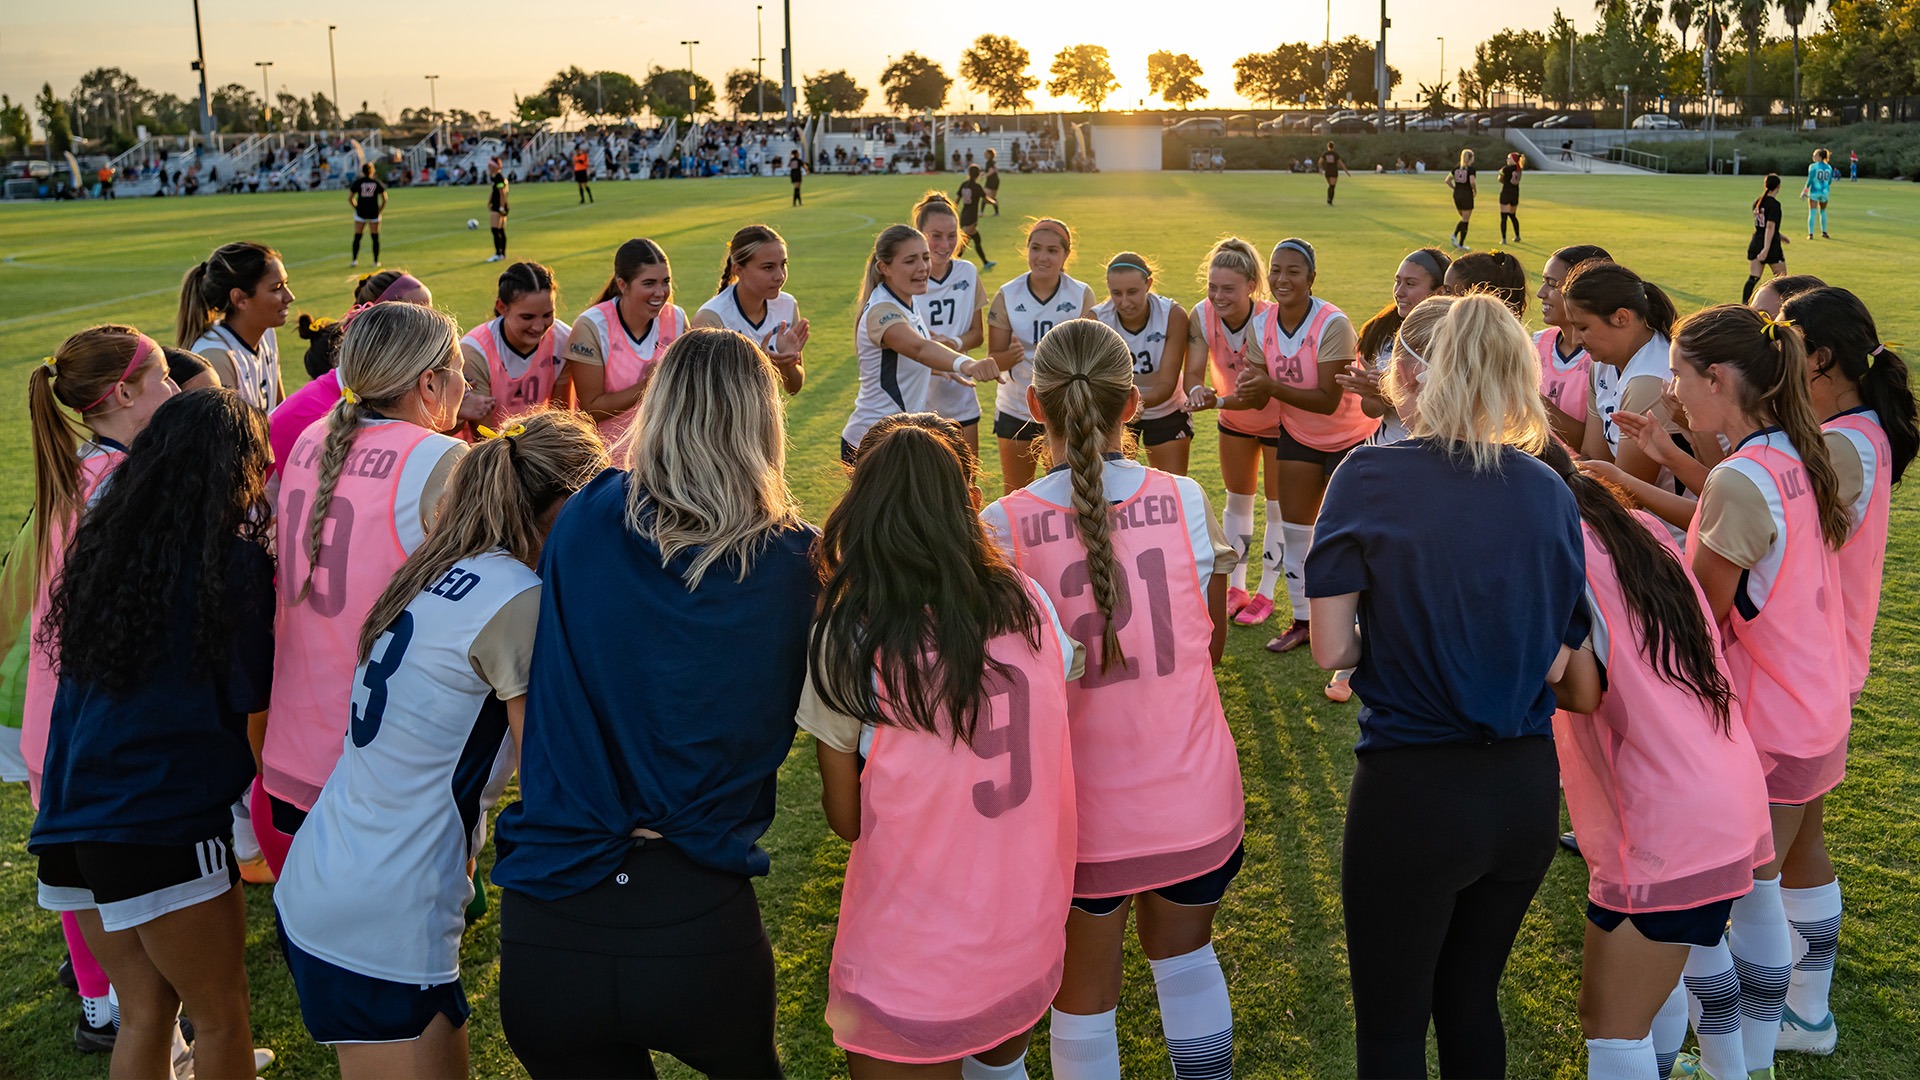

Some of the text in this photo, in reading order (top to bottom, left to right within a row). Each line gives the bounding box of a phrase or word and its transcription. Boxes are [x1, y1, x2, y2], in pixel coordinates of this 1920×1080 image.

[360, 182, 377, 198] 17
[929, 298, 955, 326] 27
[1033, 319, 1053, 345] 10
[1275, 355, 1304, 384] 29
[1021, 510, 1059, 548] UC
[285, 488, 355, 619] 19
[1060, 547, 1176, 690] 21
[971, 663, 1033, 819] 9
